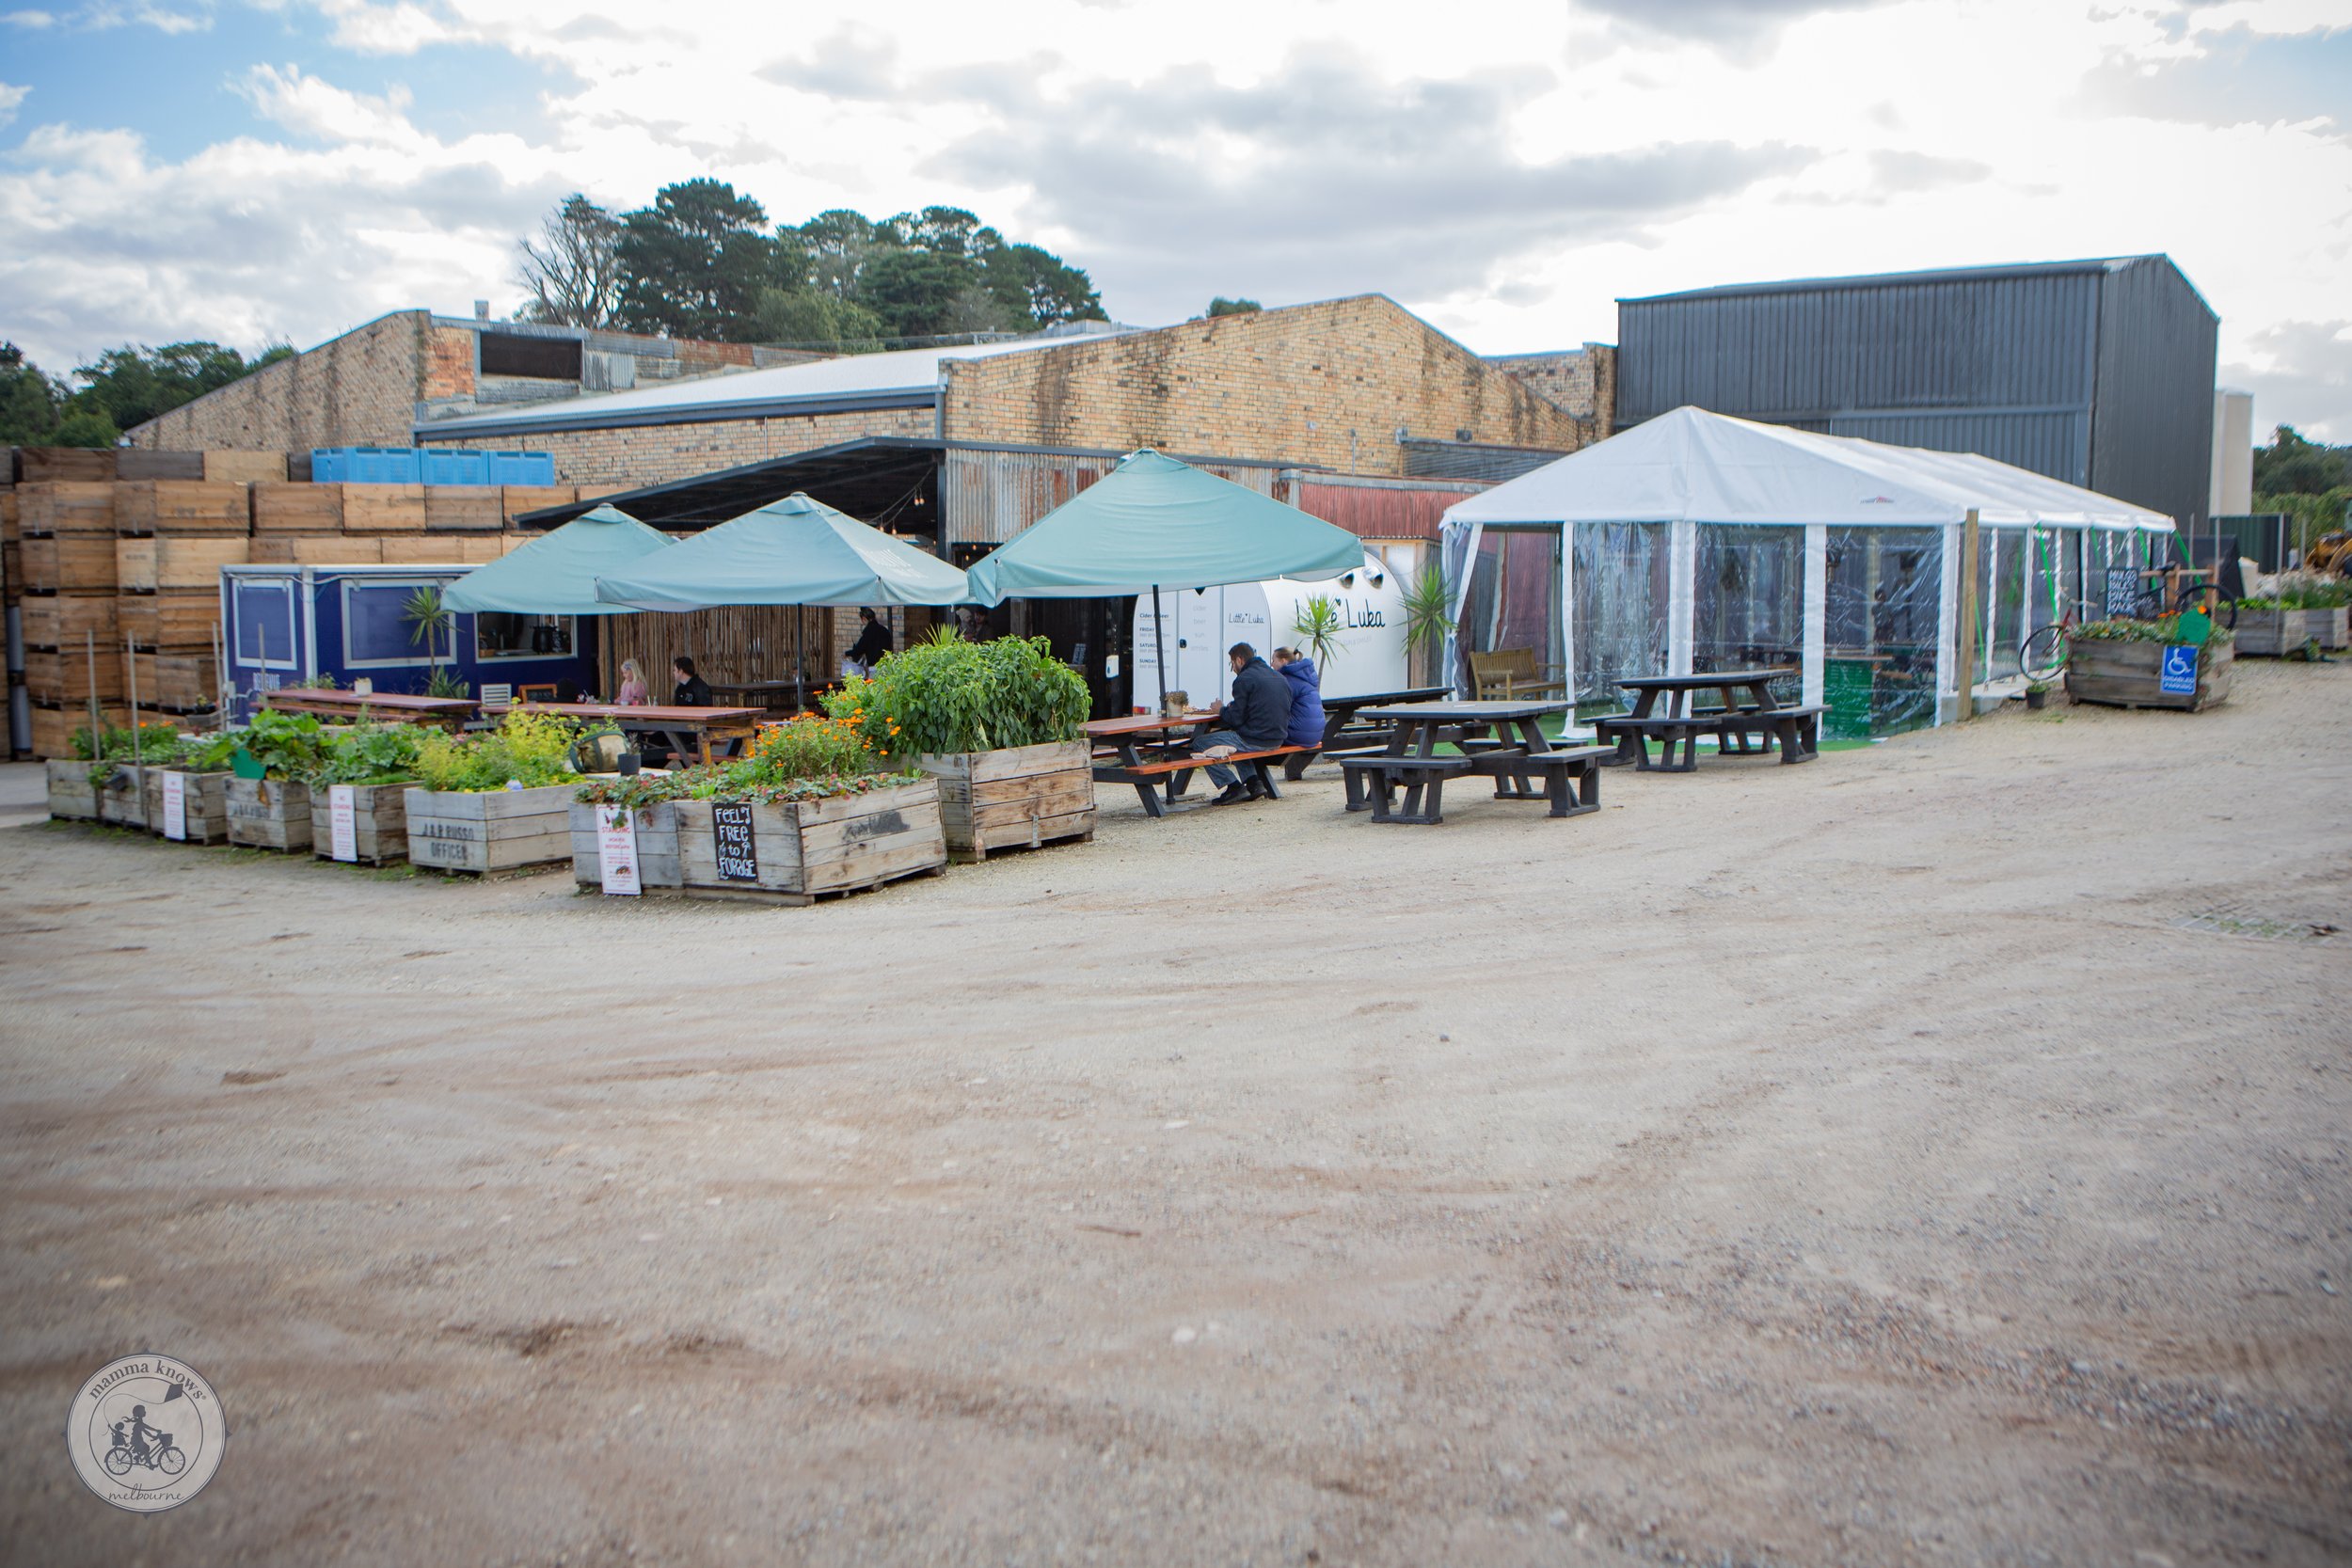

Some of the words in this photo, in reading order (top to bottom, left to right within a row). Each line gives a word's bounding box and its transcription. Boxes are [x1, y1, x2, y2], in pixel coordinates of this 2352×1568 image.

[1248, 612, 1264, 624] Luka
[1345, 598, 1385, 627] Luka
[728, 844, 740, 856] to
